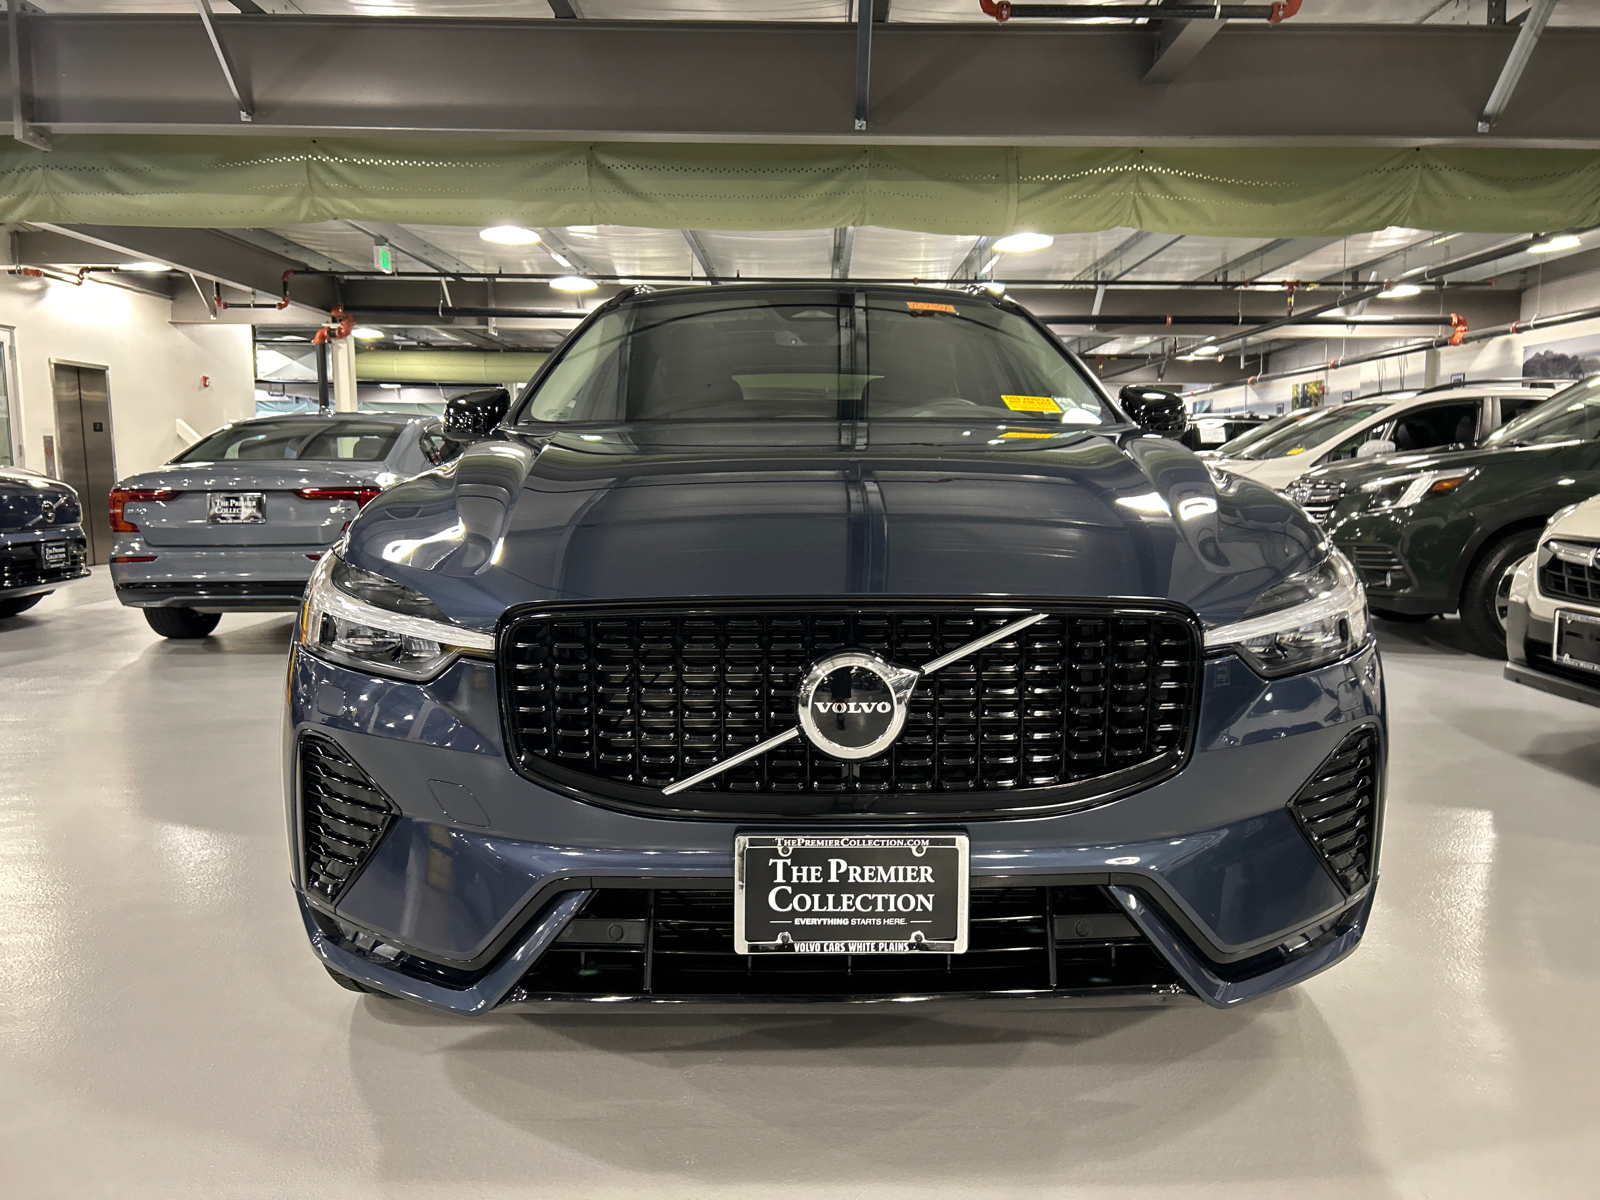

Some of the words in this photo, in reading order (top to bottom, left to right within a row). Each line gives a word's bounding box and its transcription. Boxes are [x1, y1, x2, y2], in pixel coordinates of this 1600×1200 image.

[814, 701, 891, 713] VOLVO
[768, 858, 823, 883] THE
[827, 858, 935, 883] PREMIER
[768, 886, 935, 912] COLLECTION
[794, 942, 821, 952] VOLVO
[823, 942, 846, 952] CARS
[848, 942, 876, 952] WHITE
[878, 942, 909, 952] PLAINS
